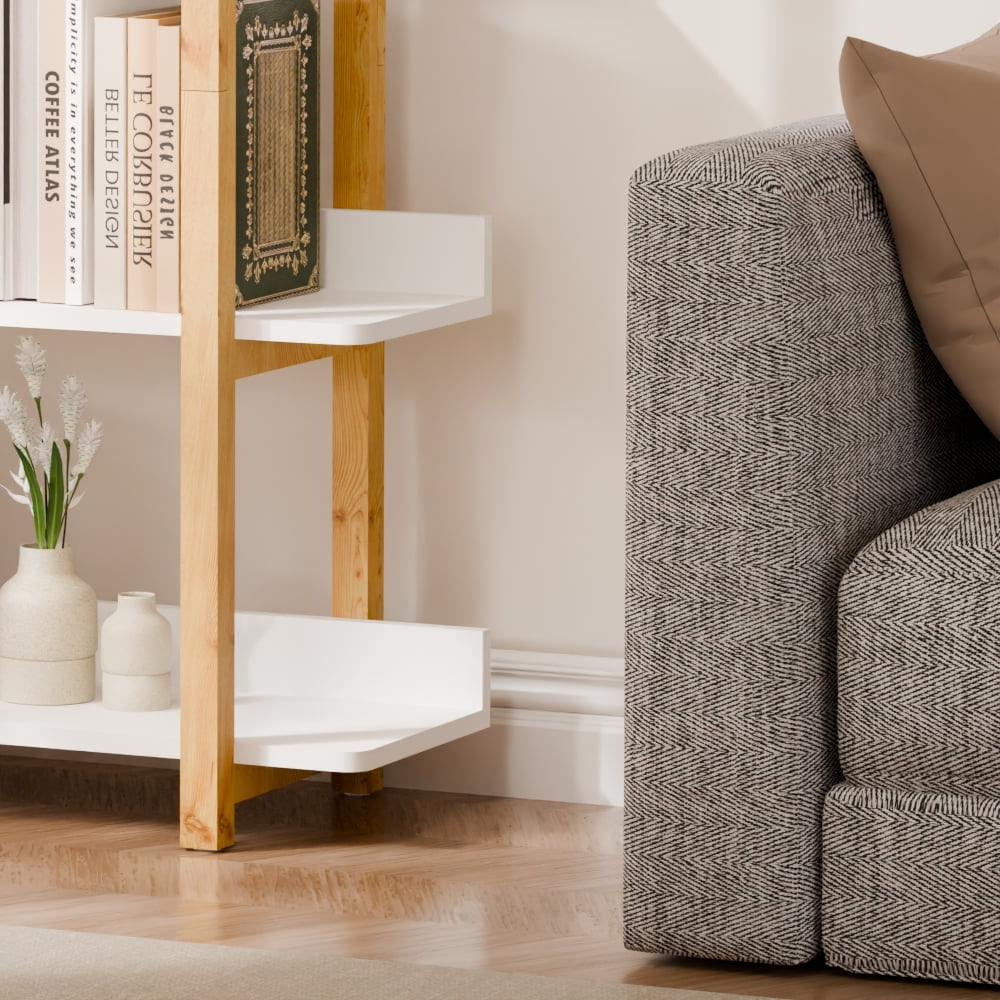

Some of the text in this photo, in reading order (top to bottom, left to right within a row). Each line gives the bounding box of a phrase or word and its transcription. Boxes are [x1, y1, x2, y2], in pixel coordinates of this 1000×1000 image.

[69, 80, 78, 96] is
[69, 102, 78, 119] in
[44, 70, 60, 203] COFFEE ATLAS
[68, 125, 78, 220] everything
[69, 226, 77, 249] we
[69, 255, 77, 285] see
